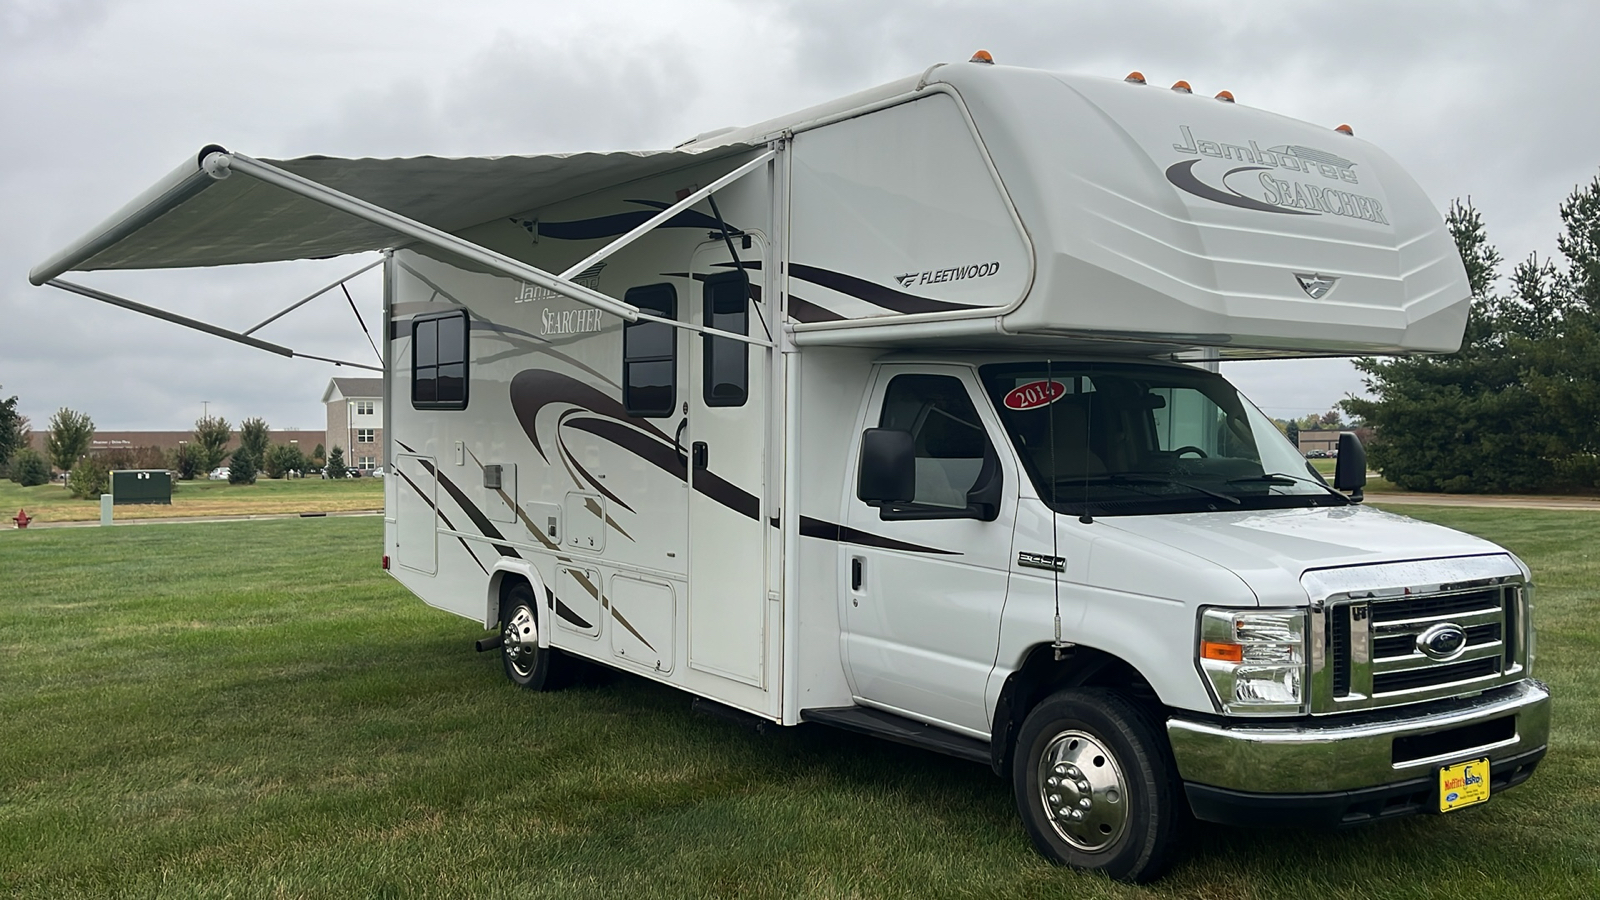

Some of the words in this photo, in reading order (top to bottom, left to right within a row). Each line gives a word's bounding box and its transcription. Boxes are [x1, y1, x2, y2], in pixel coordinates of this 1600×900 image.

[1172, 125, 1359, 185] Jamboree
[1258, 171, 1390, 226] SEARCHER
[919, 261, 1000, 286] FLEETWOOD
[541, 307, 602, 335] SEARCHER
